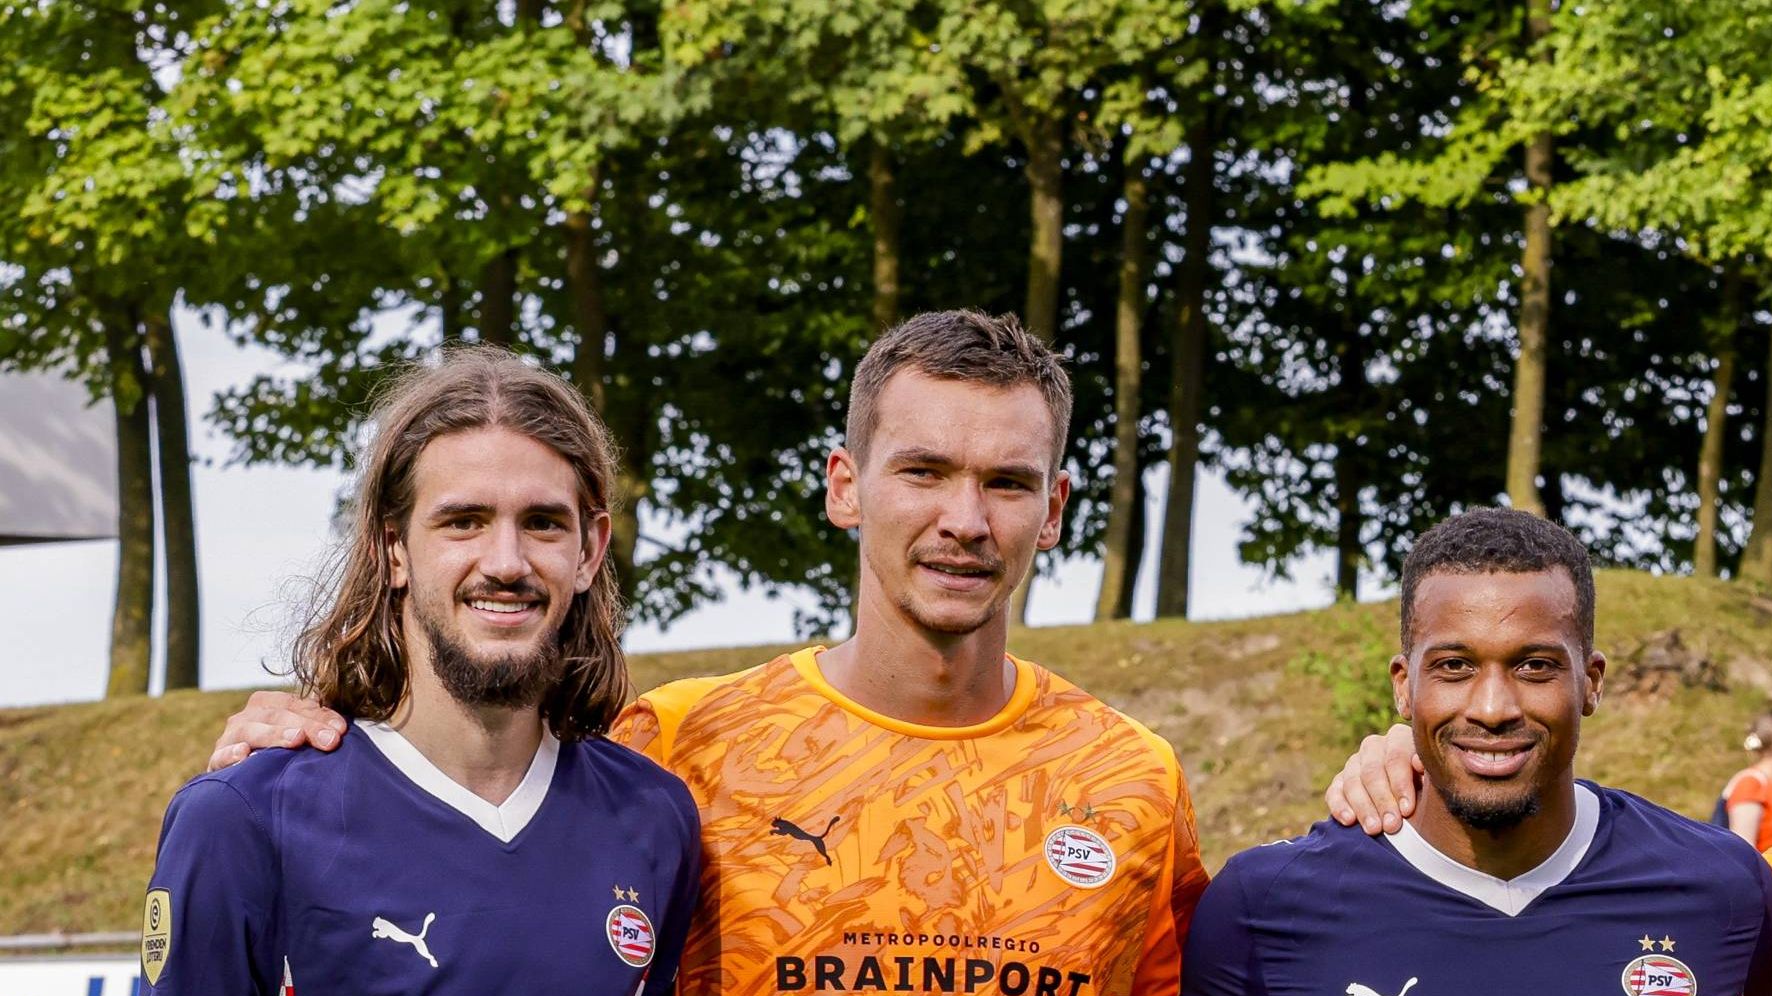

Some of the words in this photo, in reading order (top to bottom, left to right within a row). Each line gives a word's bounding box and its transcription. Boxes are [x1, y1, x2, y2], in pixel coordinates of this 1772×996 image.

[1067, 846, 1091, 860] PSV
[622, 926, 640, 941] PSV
[843, 932, 1041, 954] METROPOOLREGIO
[1648, 974, 1673, 987] PSV
